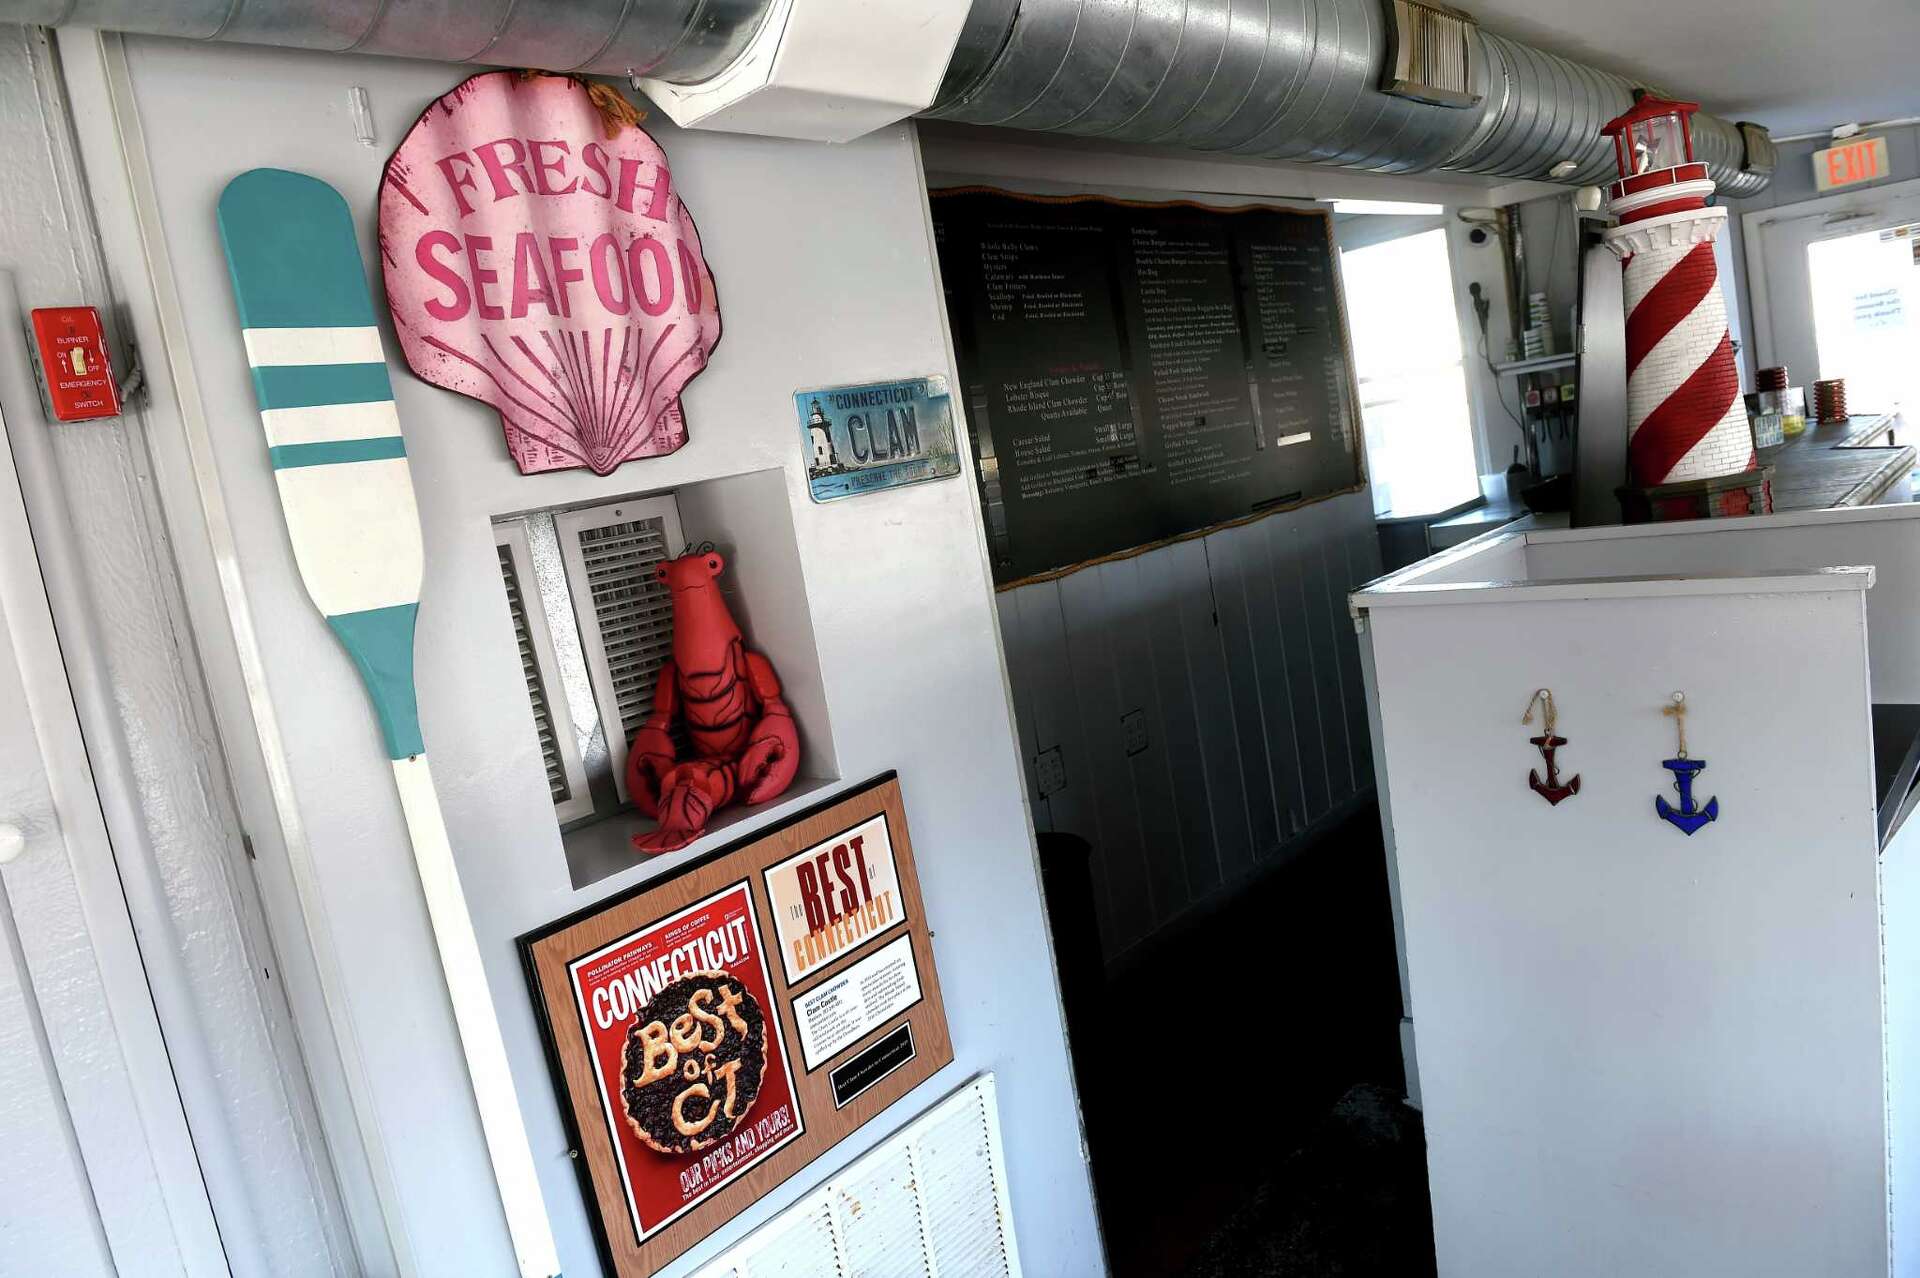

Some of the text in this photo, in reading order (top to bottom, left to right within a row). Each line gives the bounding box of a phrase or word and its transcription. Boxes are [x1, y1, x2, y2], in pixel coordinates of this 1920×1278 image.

[1827, 142, 1878, 185] EXIT
[437, 138, 671, 223] FRESH
[414, 230, 703, 322] SEAFOOD
[57, 336, 89, 344] BURNER
[60, 379, 107, 389] EMERGENCY
[1004, 383, 1018, 393] New
[1019, 378, 1043, 391] England
[1060, 374, 1086, 385] Chowder
[74, 400, 104, 409] SWITCH
[836, 386, 914, 411] CONNECTICUT
[1005, 391, 1028, 402] Lobster
[1007, 403, 1027, 413] Rhode
[1028, 399, 1046, 411] Island
[1062, 396, 1088, 407] Chowder
[847, 405, 922, 465] CLAM
[1034, 433, 1051, 444] Salad
[1035, 442, 1052, 454] Salad
[796, 835, 873, 938] BEST
[793, 890, 895, 972] CONNECTICUT
[587, 956, 621, 978] POLLINATOR
[591, 915, 749, 1030] CONNECTICUT
[806, 992, 837, 1017] Clam Castle
[671, 1059, 743, 1137] CT
[680, 1104, 792, 1193] OUR PICKS AND YOURS!
